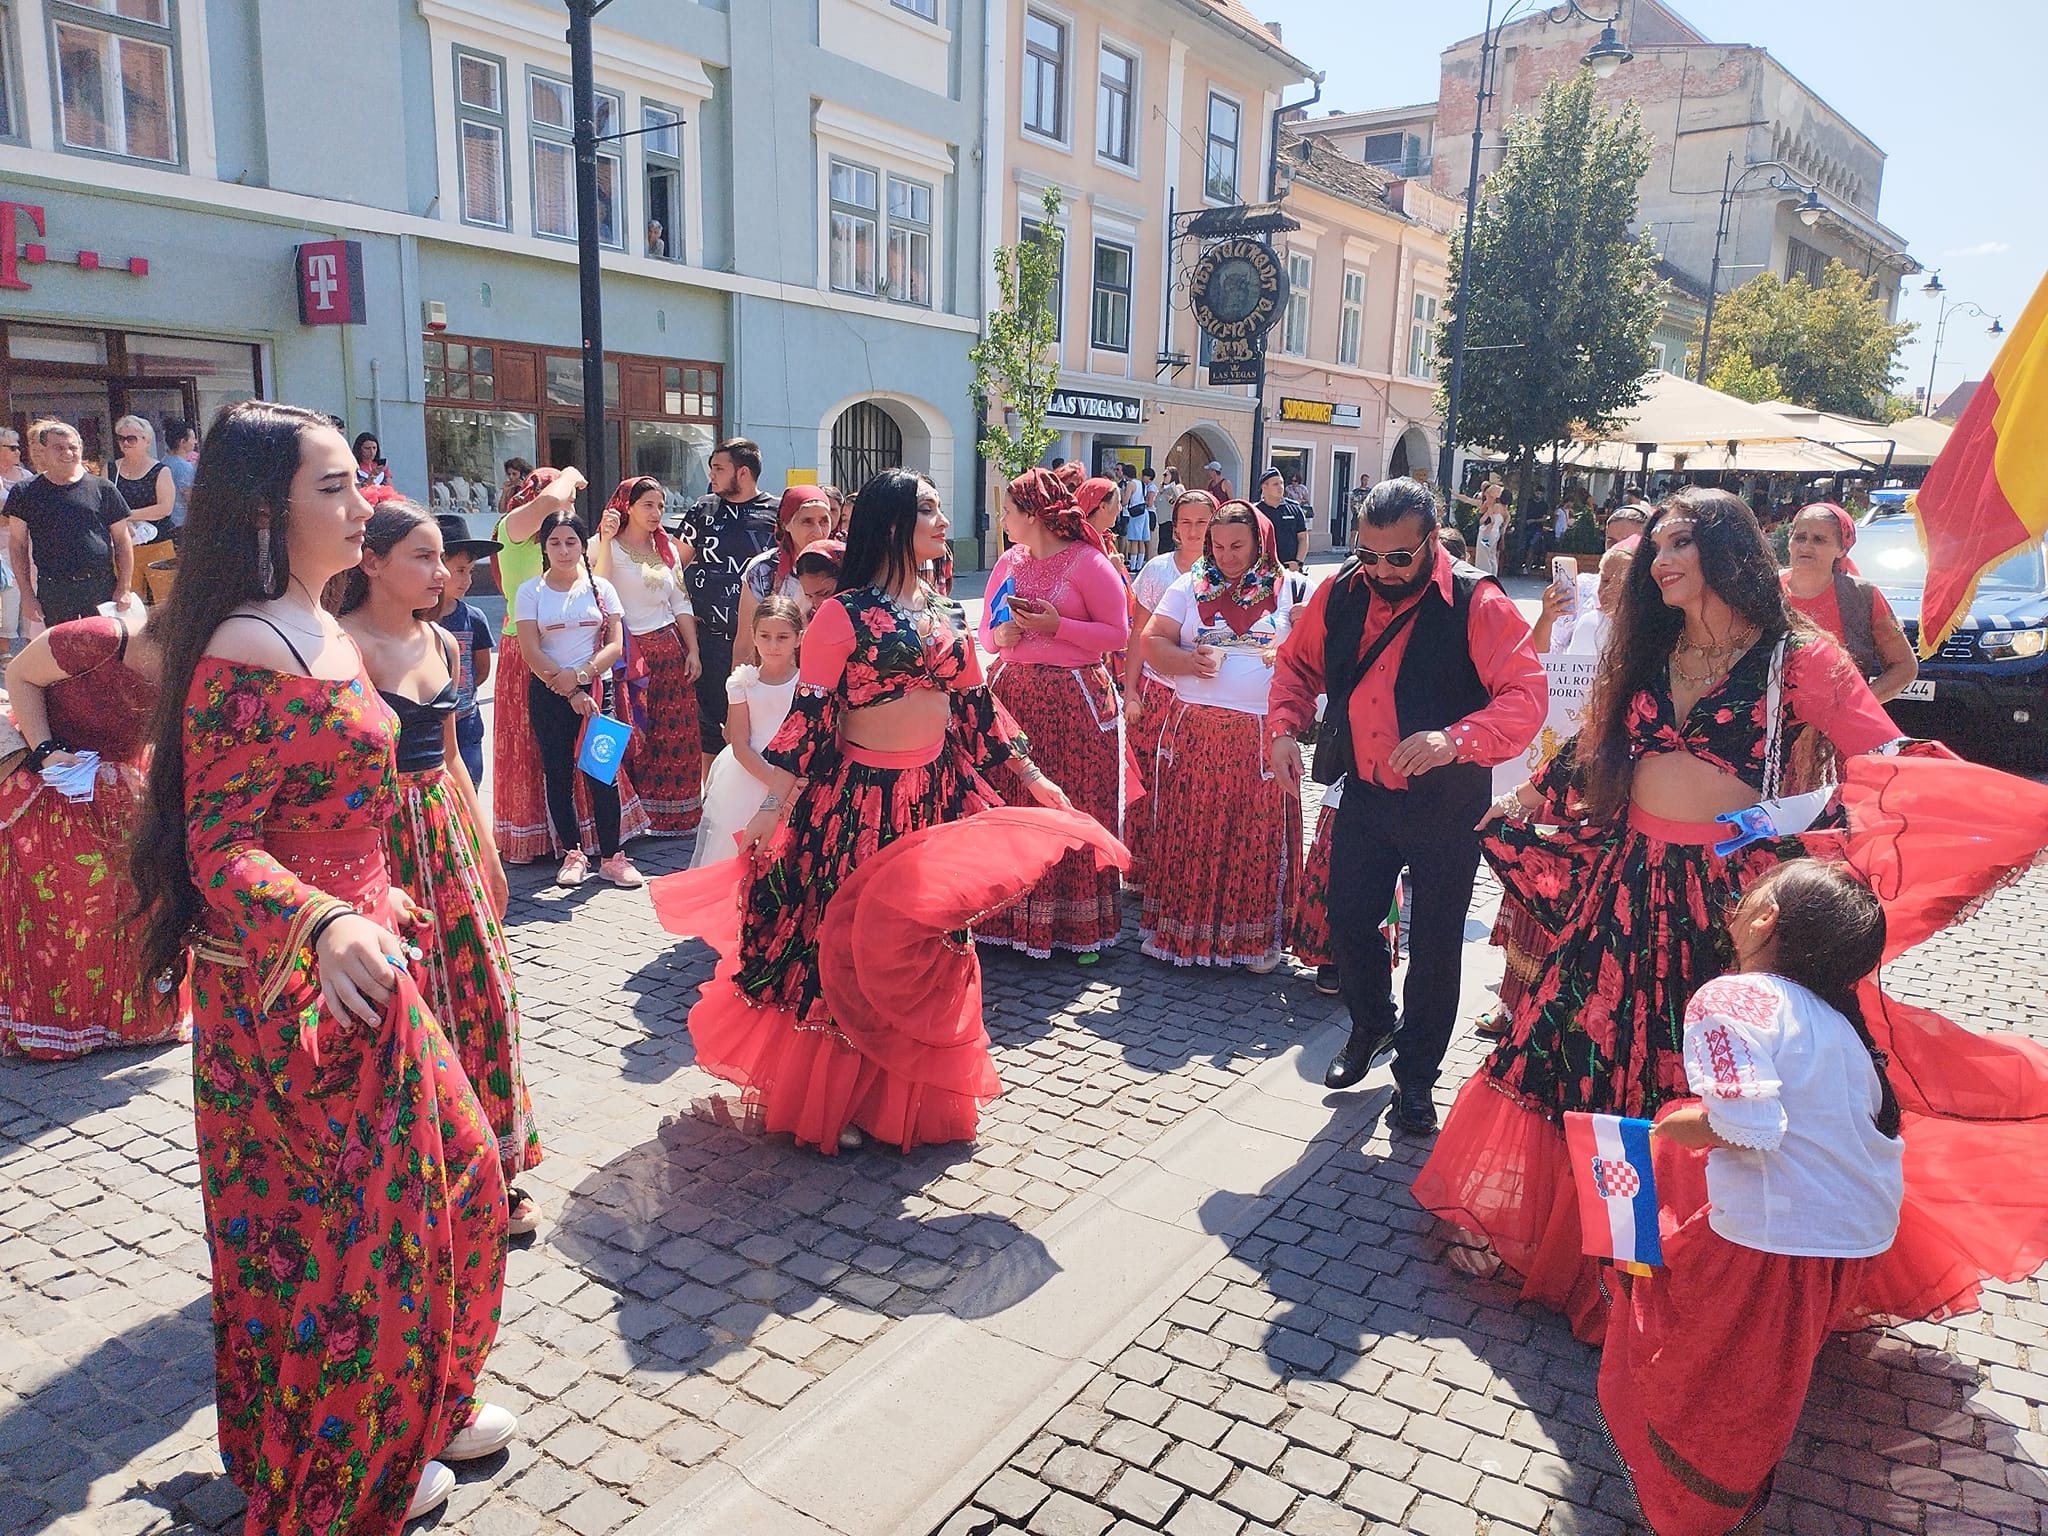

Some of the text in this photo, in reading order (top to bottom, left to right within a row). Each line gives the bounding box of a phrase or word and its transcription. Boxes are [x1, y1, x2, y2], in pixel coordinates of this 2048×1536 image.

[308, 254, 337, 310] T
[1212, 370, 1257, 379] LAS VEGAS
[1045, 394, 1124, 419] LAS VEGAS
[1283, 399, 1334, 423] SUPERMARKET
[702, 536, 724, 564] R
[1556, 676, 1594, 686] AL RO
